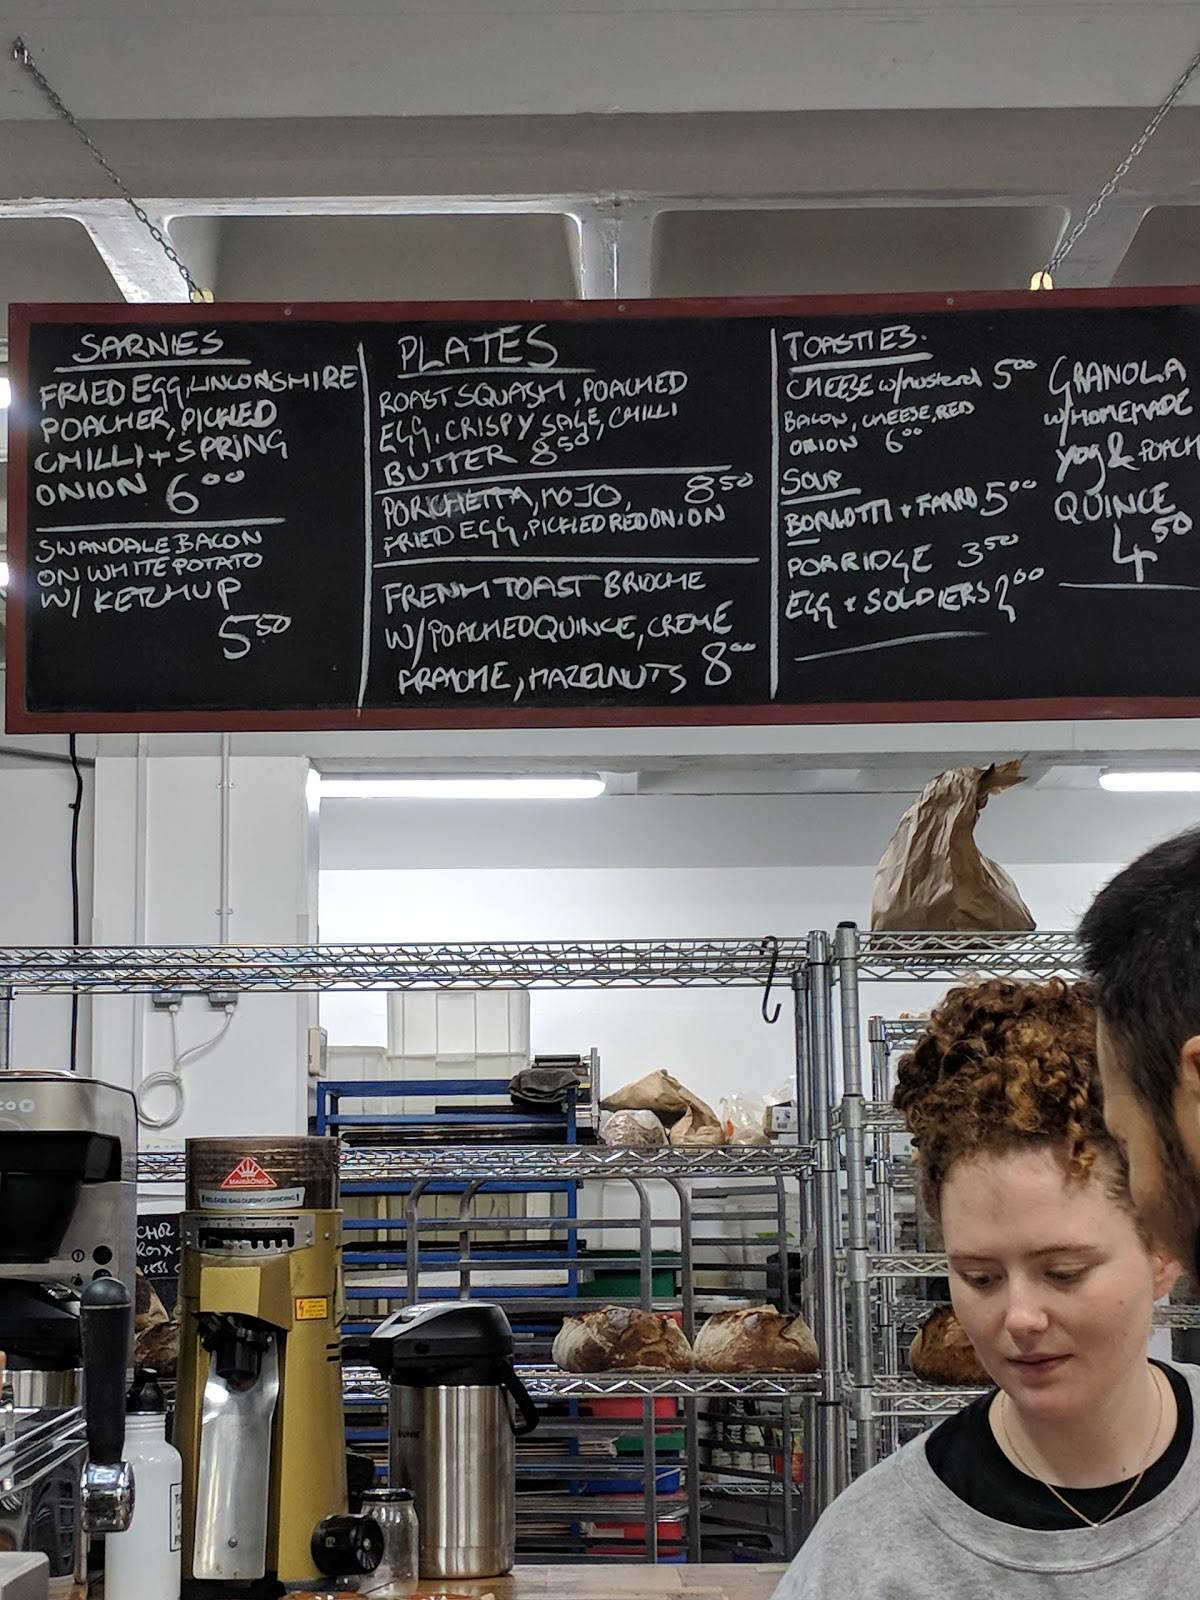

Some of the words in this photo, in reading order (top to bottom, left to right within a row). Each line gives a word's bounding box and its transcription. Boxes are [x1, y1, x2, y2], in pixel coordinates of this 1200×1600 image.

[73, 330, 223, 363] SARNIES
[398, 324, 558, 372] PLATES
[39, 378, 125, 411] FRIED
[379, 385, 453, 418] ROAST
[583, 370, 688, 403] POACHED
[1049, 355, 1187, 404] GRANOLA
[445, 412, 534, 441] CRISPY
[608, 402, 678, 429] CHILLI
[934, 400, 976, 422] RED
[34, 444, 143, 473] CHILLI
[175, 429, 288, 464] SPRING
[789, 435, 858, 456] ONION
[383, 444, 518, 487] BUTTER
[781, 468, 842, 495] SOUP
[35, 472, 148, 507] ONION
[1054, 481, 1176, 525] QUINCE
[172, 530, 263, 554] BACON
[383, 523, 455, 558] FRIED
[528, 511, 606, 536] PICKLED
[609, 510, 649, 532] RED
[649, 503, 726, 530] ONION
[36, 565, 79, 587] ON
[87, 555, 167, 582] WHITE
[174, 552, 264, 575] POTATO
[787, 543, 933, 584] PORRIDGE
[94, 577, 241, 614] KETCHUP
[493, 573, 601, 599] TOAST
[603, 569, 707, 599] BRIOCHE
[784, 589, 838, 629] EGG
[863, 580, 990, 615] SOLDIERS
